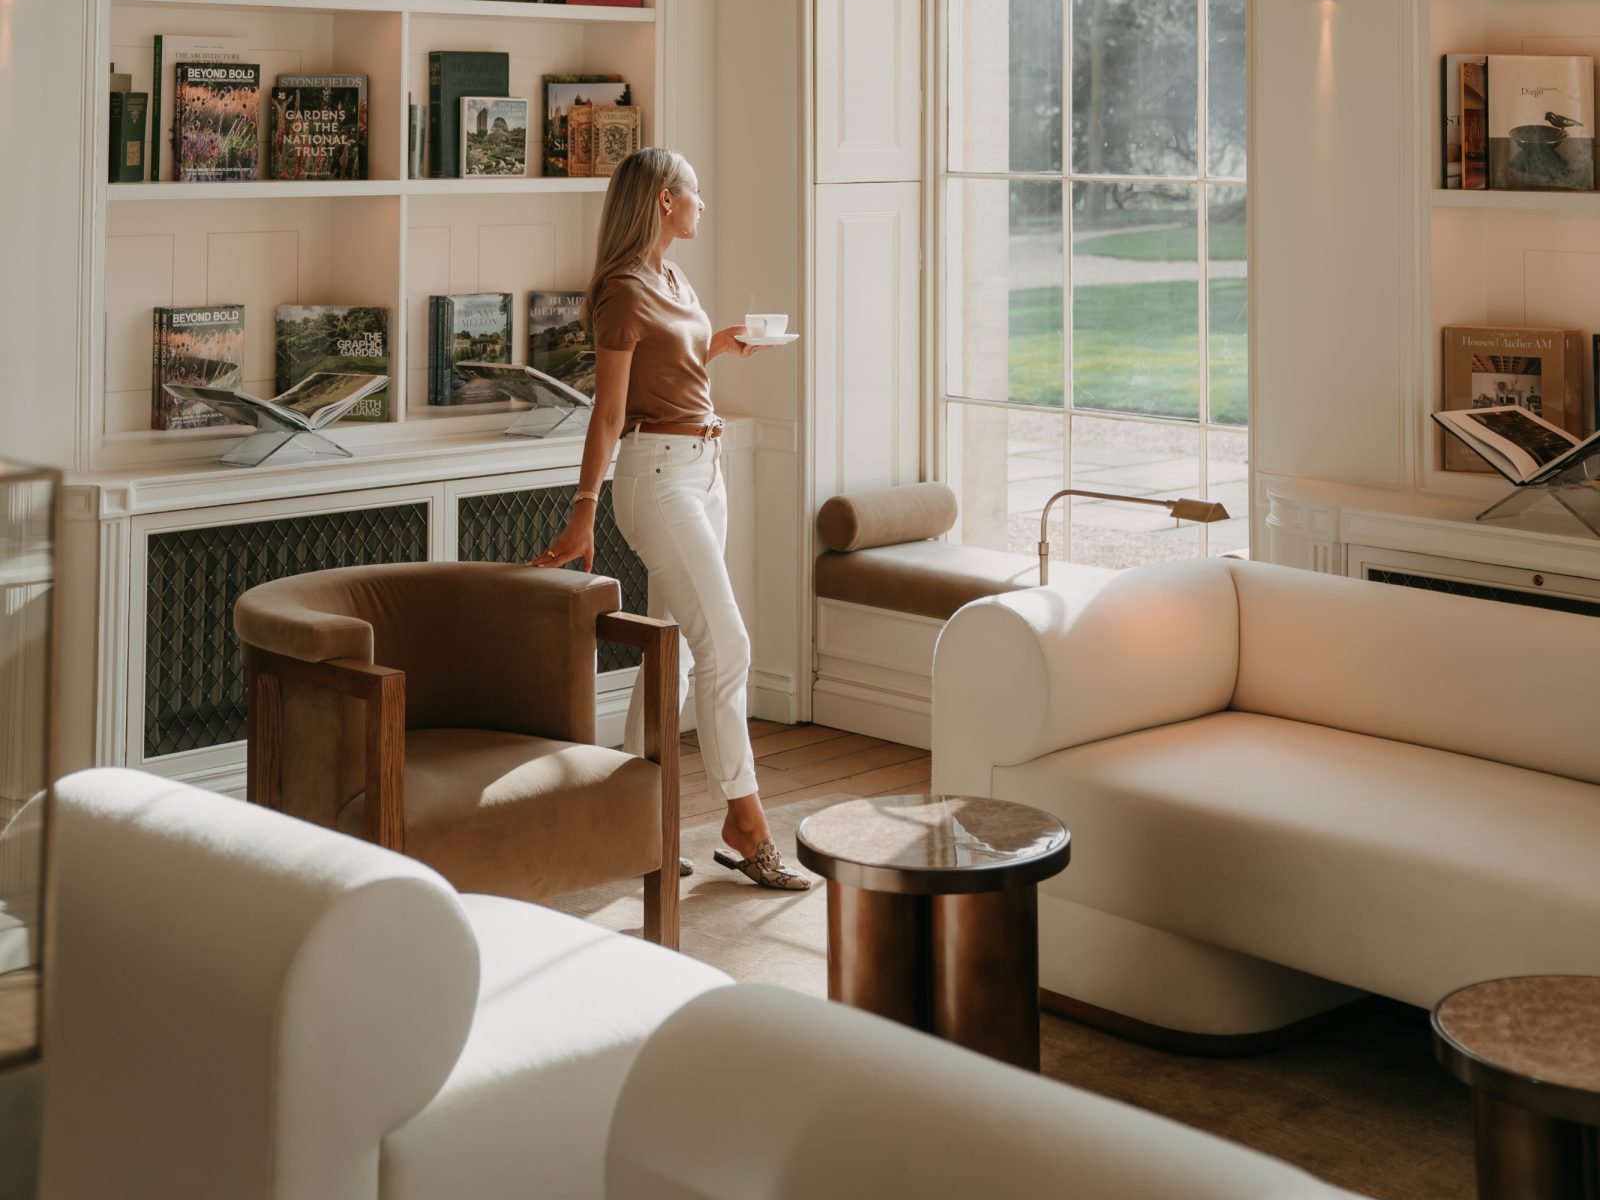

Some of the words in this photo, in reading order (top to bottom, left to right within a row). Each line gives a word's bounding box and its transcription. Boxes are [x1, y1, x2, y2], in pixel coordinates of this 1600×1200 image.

[187, 68, 227, 78] BEYOND
[228, 69, 255, 79] BOLD
[280, 77, 362, 88] STONEFIELDS
[1520, 87, 1544, 98] Diego
[285, 110, 346, 120] GARDENS
[292, 122, 309, 132] OF
[314, 122, 339, 132] THE
[283, 134, 348, 145] NATIONAL
[295, 146, 335, 157] TRUST
[172, 313, 211, 323] BEYOND
[213, 310, 239, 321] BOLD
[362, 332, 382, 341] THE
[337, 340, 383, 349] GRAPHIC
[1461, 335, 1494, 347] Houses
[1501, 337, 1532, 349] Atelier
[1534, 339, 1552, 350] AM
[340, 348, 383, 357] GARDEN
